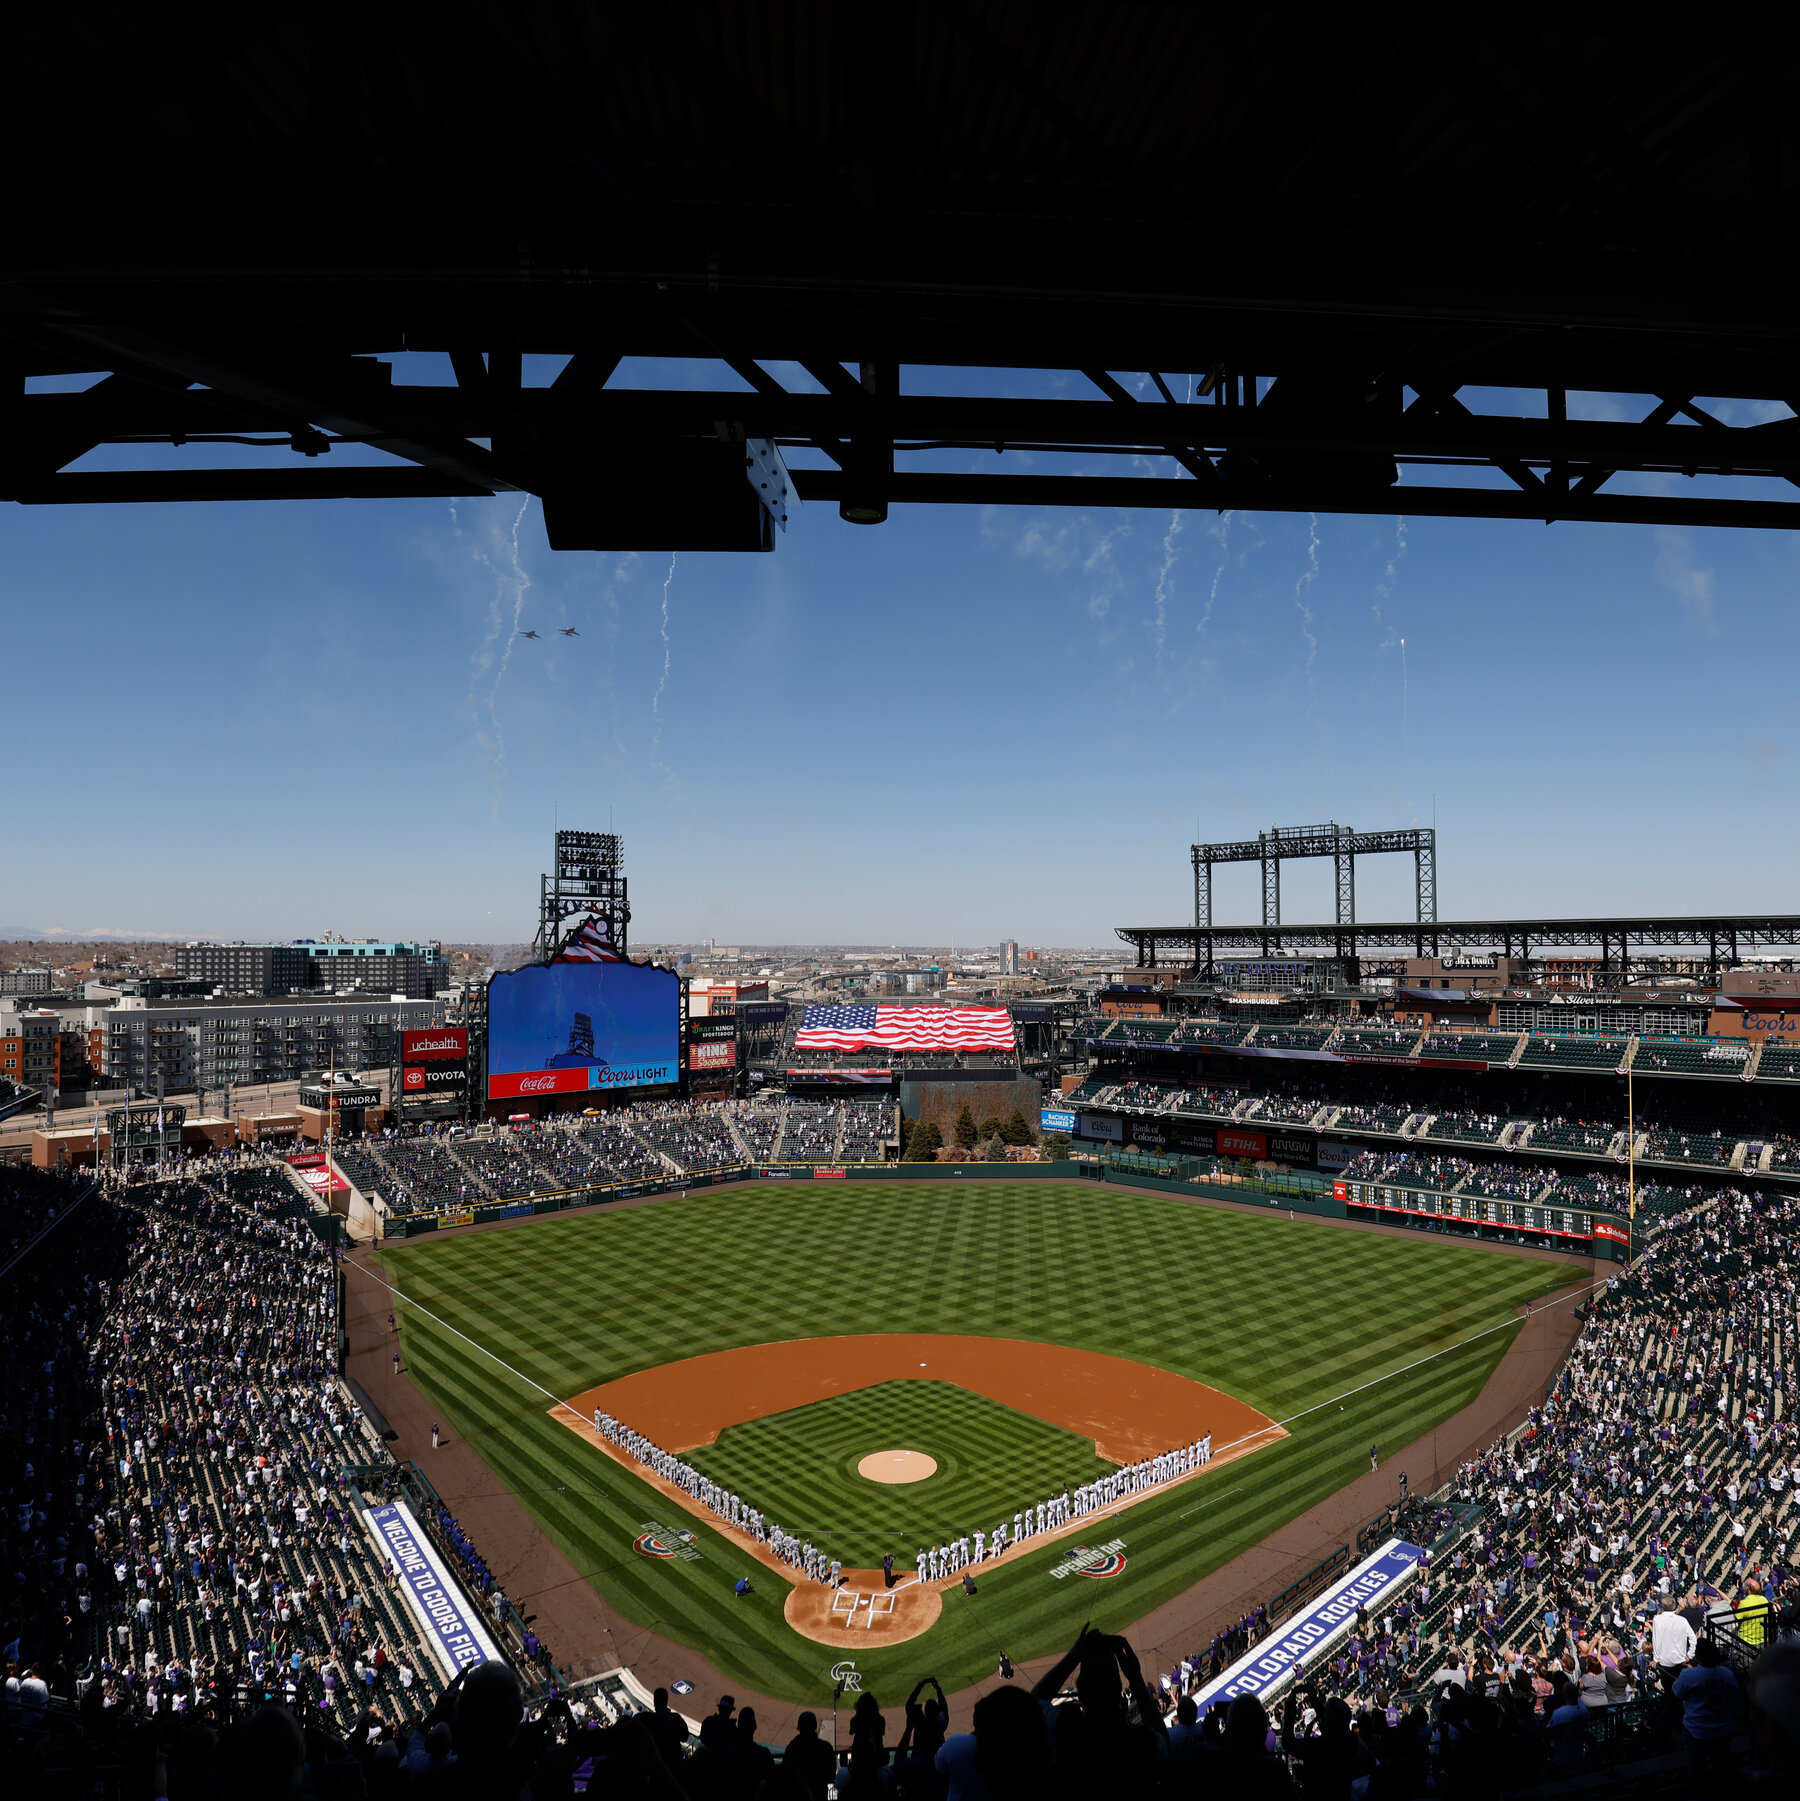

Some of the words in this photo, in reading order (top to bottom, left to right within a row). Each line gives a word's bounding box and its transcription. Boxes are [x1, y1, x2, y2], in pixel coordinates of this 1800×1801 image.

[1116, 998, 1144, 1009] Coors
[1566, 995, 1595, 1005] Silver
[1741, 1012, 1796, 1031] Coors
[412, 1037, 458, 1051] uchealth
[697, 1044, 728, 1057] KING
[426, 1071, 465, 1081] TOYOTA
[598, 1067, 635, 1083] Coors
[636, 1067, 667, 1080] LIGHT
[520, 1076, 557, 1091] Coca-Cola
[338, 1095, 377, 1106] TUNDRA
[1092, 1121, 1112, 1132] Coors
[1133, 1123, 1150, 1132] Bank
[1151, 1125, 1159, 1134] of
[1133, 1132, 1165, 1143] Colorado
[1223, 1138, 1260, 1151] STIHL
[1272, 1139, 1311, 1153] ARROW
[293, 1155, 320, 1164] uchealth
[1319, 1149, 1346, 1162] Coors
[382, 1519, 427, 1573] WELCOME
[640, 1521, 686, 1550] OPENING
[674, 1546, 704, 1562] DAY
[1049, 1549, 1107, 1579] OPENING
[1100, 1538, 1127, 1555] DAY
[412, 1572, 436, 1590] TO
[422, 1589, 462, 1635] COORS
[1225, 1622, 1325, 1698] COLORADO
[1317, 1570, 1390, 1625] ROCKIES
[447, 1633, 482, 1667] FIEL
